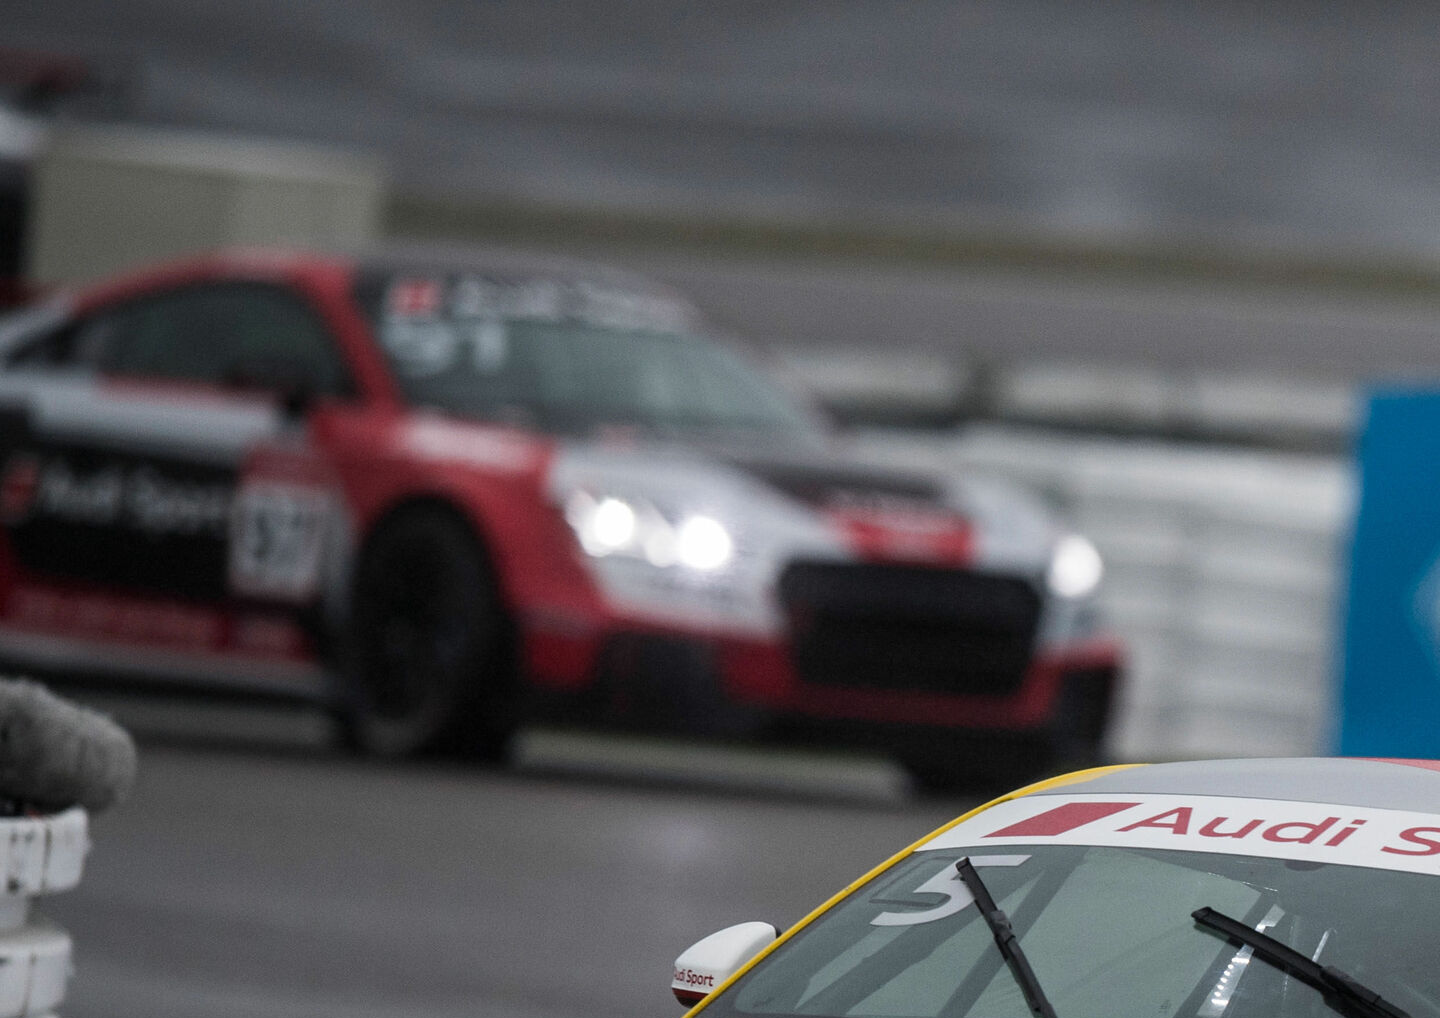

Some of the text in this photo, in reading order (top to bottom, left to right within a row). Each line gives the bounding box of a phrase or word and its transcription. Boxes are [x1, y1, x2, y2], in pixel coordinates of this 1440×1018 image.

[1115, 806, 1368, 847] Audi
[869, 854, 1033, 927] 5
[686, 969, 714, 987] Sport
